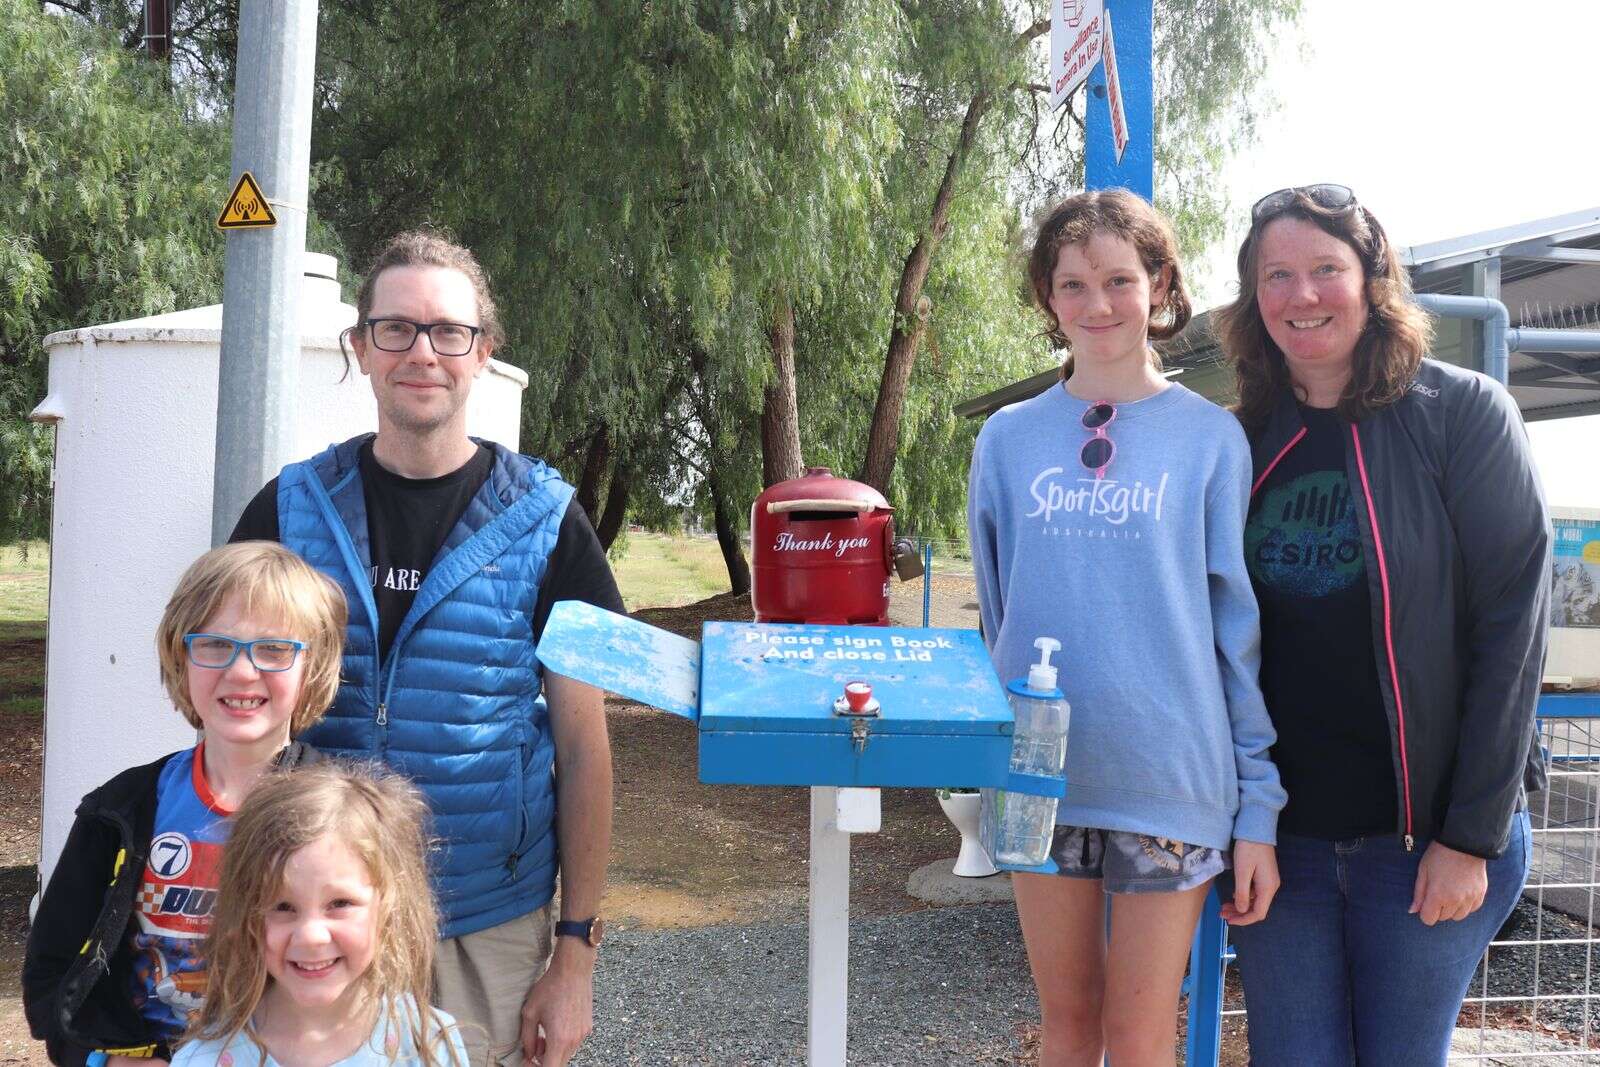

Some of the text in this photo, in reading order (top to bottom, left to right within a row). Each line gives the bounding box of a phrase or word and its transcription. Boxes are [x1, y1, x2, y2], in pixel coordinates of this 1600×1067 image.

[1063, 16, 1099, 68] Surveillance
[1056, 38, 1099, 95] Camera In Use
[1025, 467, 1169, 525] Sportsgirl
[773, 532, 871, 558] Thank you
[1042, 527, 1142, 539] AUSTRALIA
[1256, 540, 1360, 567] CSIRO
[384, 567, 421, 591] ARE
[745, 631, 954, 650] Please sign Book
[763, 645, 933, 663] And close Lid
[158, 841, 184, 876] 7
